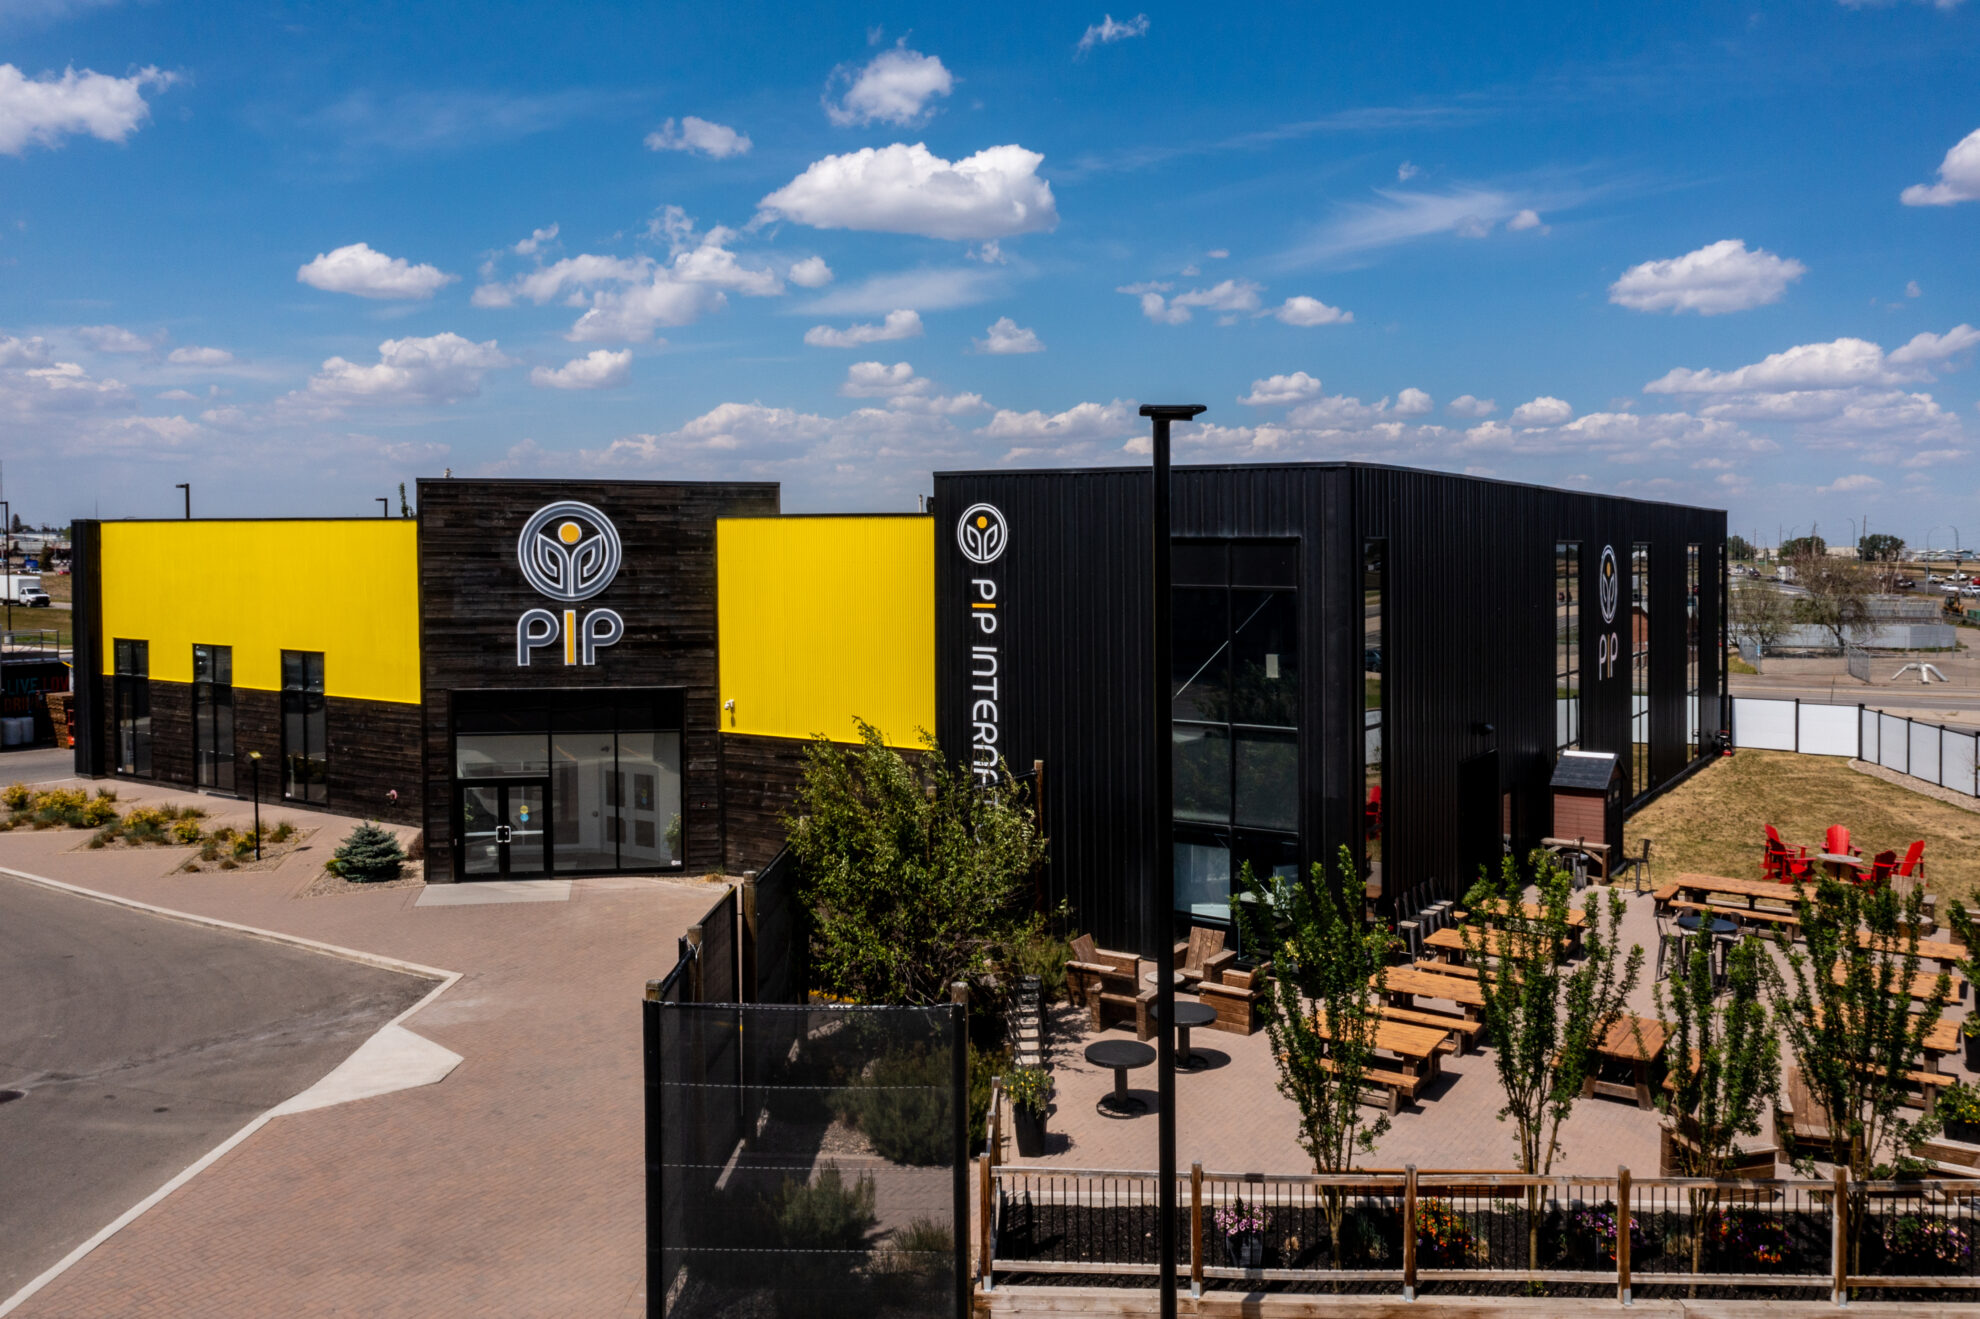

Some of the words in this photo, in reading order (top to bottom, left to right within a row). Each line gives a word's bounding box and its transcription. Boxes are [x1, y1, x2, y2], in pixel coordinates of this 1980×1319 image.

[972, 579, 997, 634] PIP
[517, 608, 624, 666] PIP
[1599, 632, 1618, 681] PIP
[7, 677, 38, 695] LIVE
[42, 675, 69, 691] LOV
